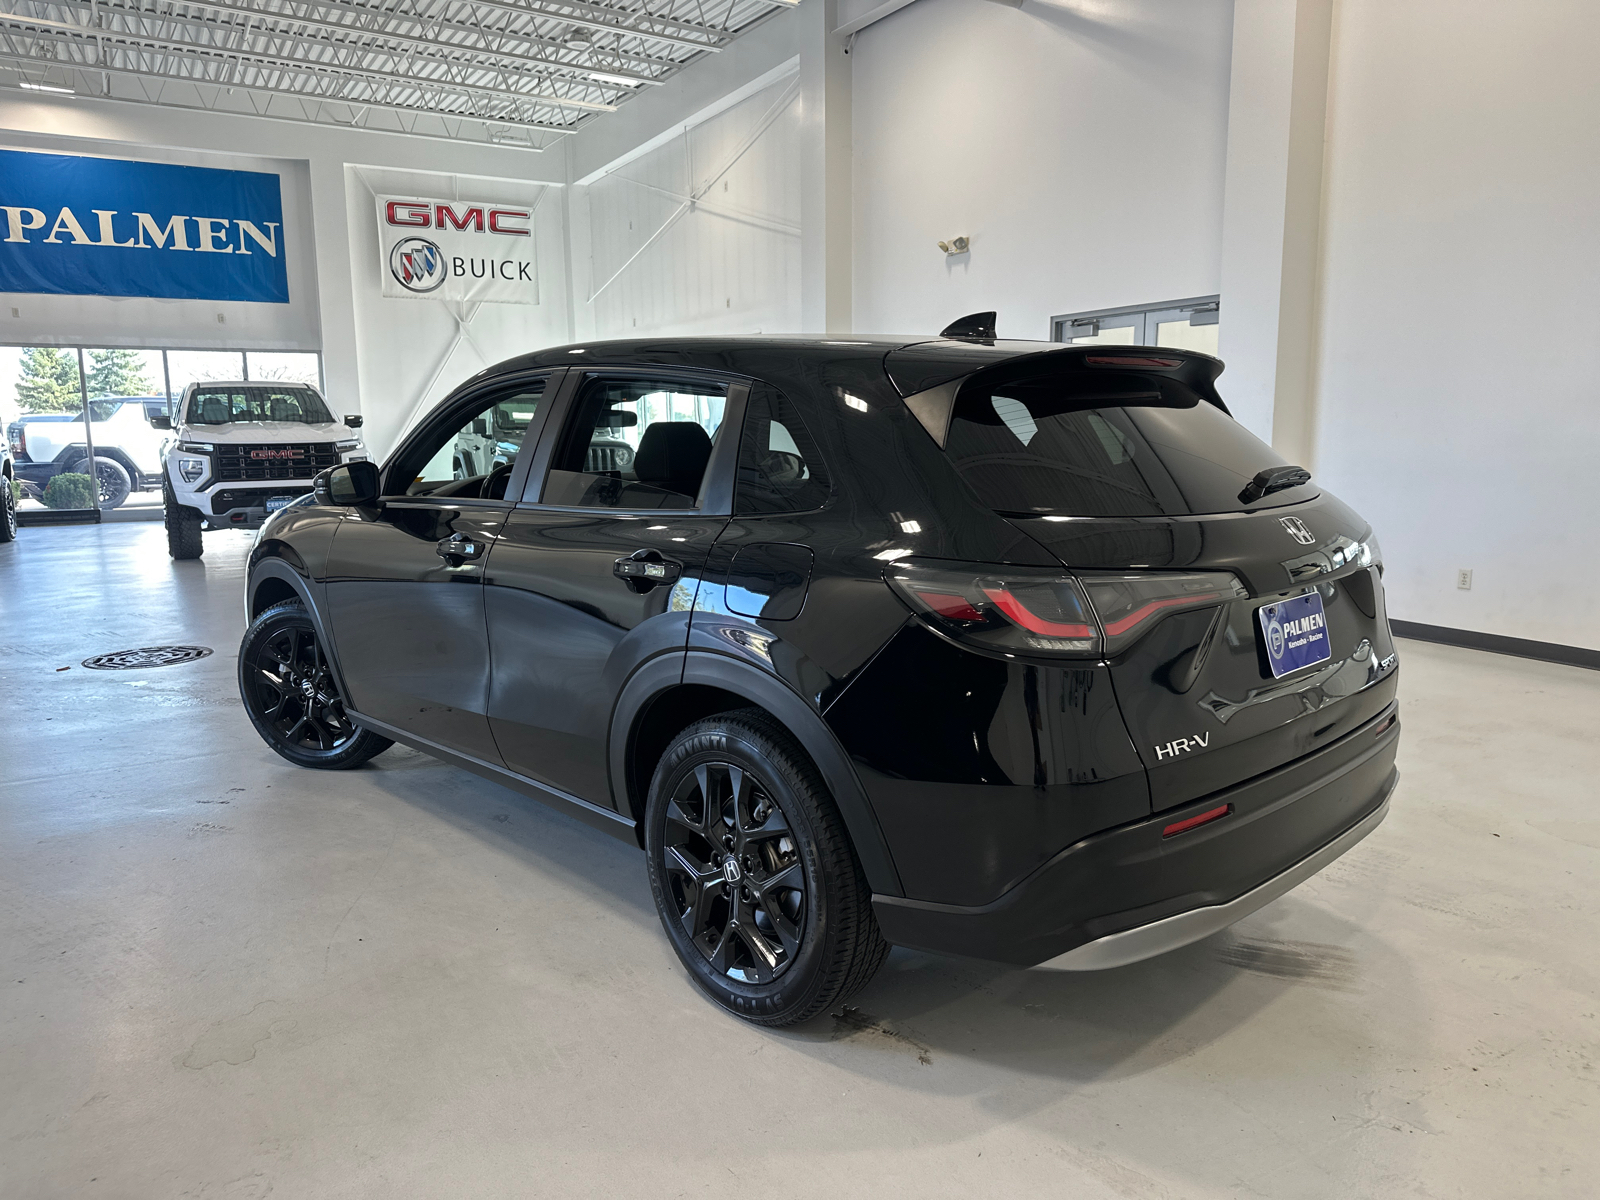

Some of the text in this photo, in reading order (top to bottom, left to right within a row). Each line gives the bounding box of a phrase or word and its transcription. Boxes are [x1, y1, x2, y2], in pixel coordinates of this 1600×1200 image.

[0, 206, 280, 257] PALMEN
[385, 200, 531, 237] GMC
[453, 257, 532, 281] BUICK
[251, 450, 304, 460] GMC
[1283, 612, 1324, 639] PALMEN
[1288, 636, 1307, 649] Kenosha
[1309, 632, 1324, 642] Racine
[669, 735, 728, 768] ADVANTA
[1154, 731, 1209, 760] HR-V
